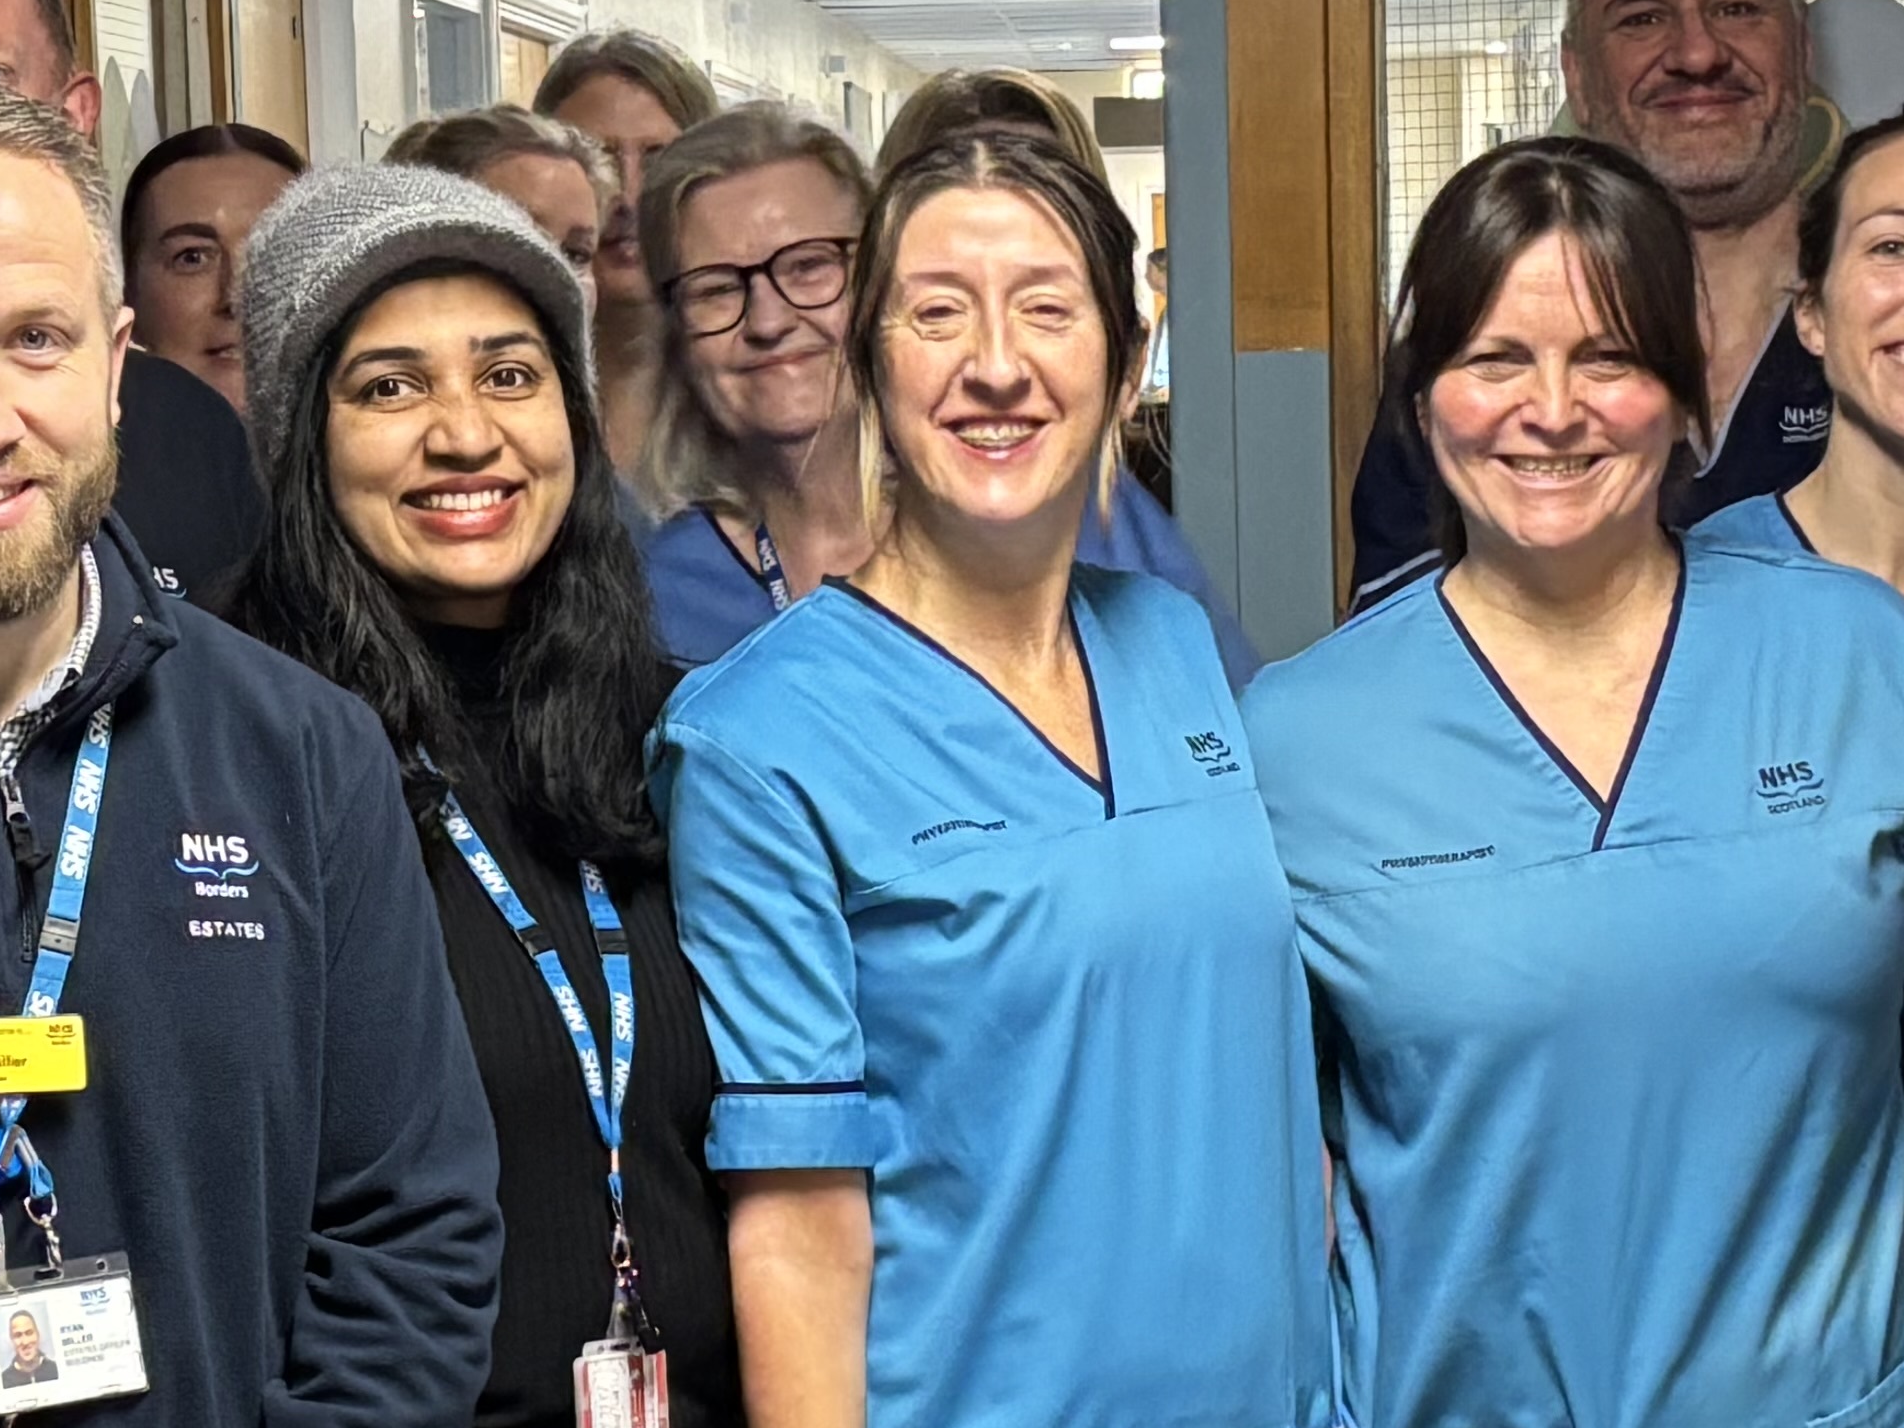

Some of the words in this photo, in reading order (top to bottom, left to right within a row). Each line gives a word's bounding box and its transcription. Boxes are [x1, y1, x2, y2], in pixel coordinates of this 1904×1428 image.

[1784, 405, 1828, 424] NHS
[73, 758, 104, 814] NHS
[1758, 761, 1814, 789] NHS
[59, 825, 92, 880] NHS
[181, 833, 249, 864] NHS
[195, 880, 249, 898] Borders
[468, 851, 509, 894] NHS
[188, 919, 265, 941] ESTATES
[552, 984, 588, 1032] NHS
[613, 991, 635, 1044] NHS
[578, 1048, 604, 1098] NHS
